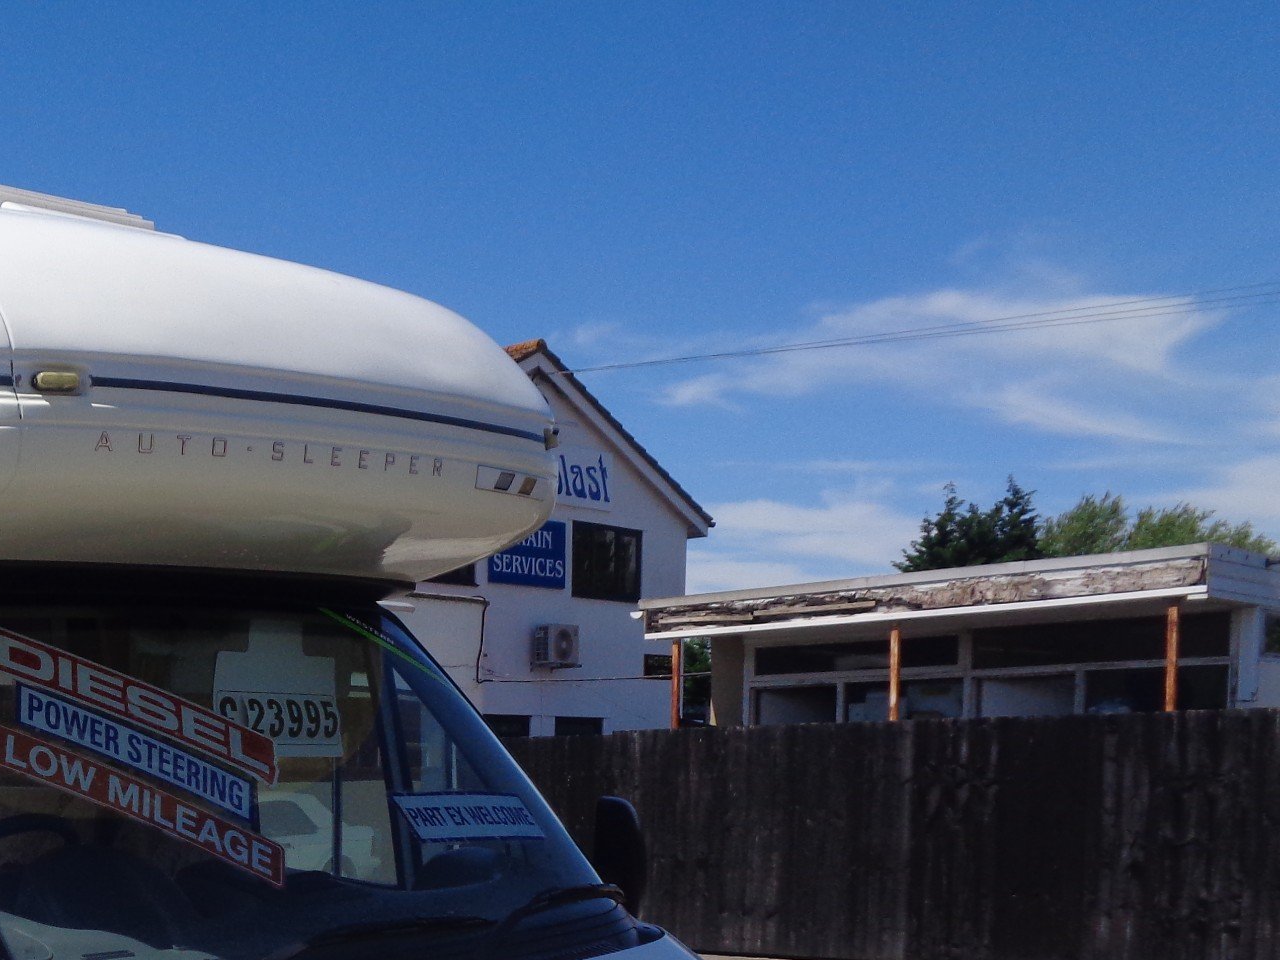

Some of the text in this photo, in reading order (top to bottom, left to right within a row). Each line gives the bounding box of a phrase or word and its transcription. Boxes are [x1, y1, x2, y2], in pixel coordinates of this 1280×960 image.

[557, 454, 611, 503] last
[522, 530, 553, 549] AIN
[493, 553, 564, 578] SERVICES
[26, 692, 244, 812] POWER STEERING
[4, 734, 273, 876] LOW MILEAGE
[405, 805, 535, 826] PART EX WELCOME
